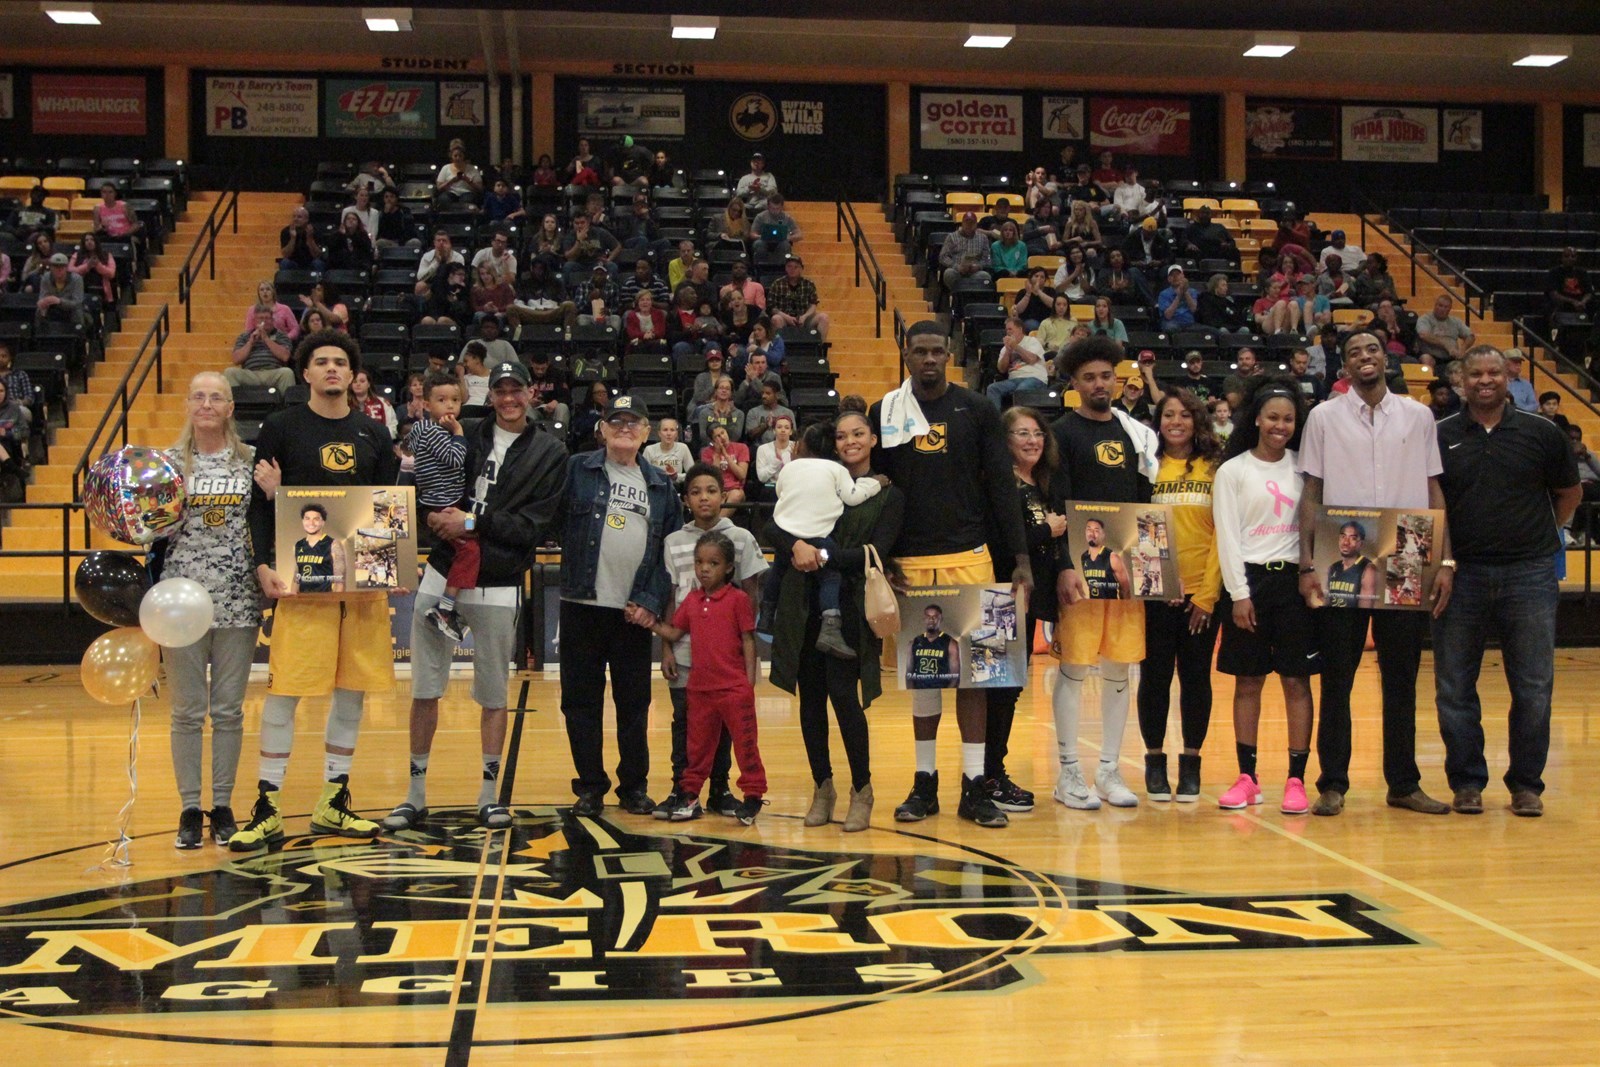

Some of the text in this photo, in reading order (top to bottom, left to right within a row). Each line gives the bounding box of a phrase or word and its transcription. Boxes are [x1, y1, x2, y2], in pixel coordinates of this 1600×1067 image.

[381, 58, 470, 70] STUDENT
[613, 64, 695, 75] SECTION
[212, 80, 313, 92] Pam & Barry's Team
[37, 96, 140, 113] WHATABURGER
[347, 90, 411, 113] EZ GO
[781, 101, 823, 109] BUFFALO
[783, 110, 823, 123] WILD
[927, 100, 1008, 121] golden
[215, 106, 248, 130] PB
[1100, 106, 1180, 136] Coca-Cola
[782, 124, 823, 134] WINGS
[940, 118, 1016, 135] corral
[1353, 120, 1383, 140] PAPA
[1151, 482, 1211, 495] CAMERON
[915, 648, 945, 658] CAMERON
